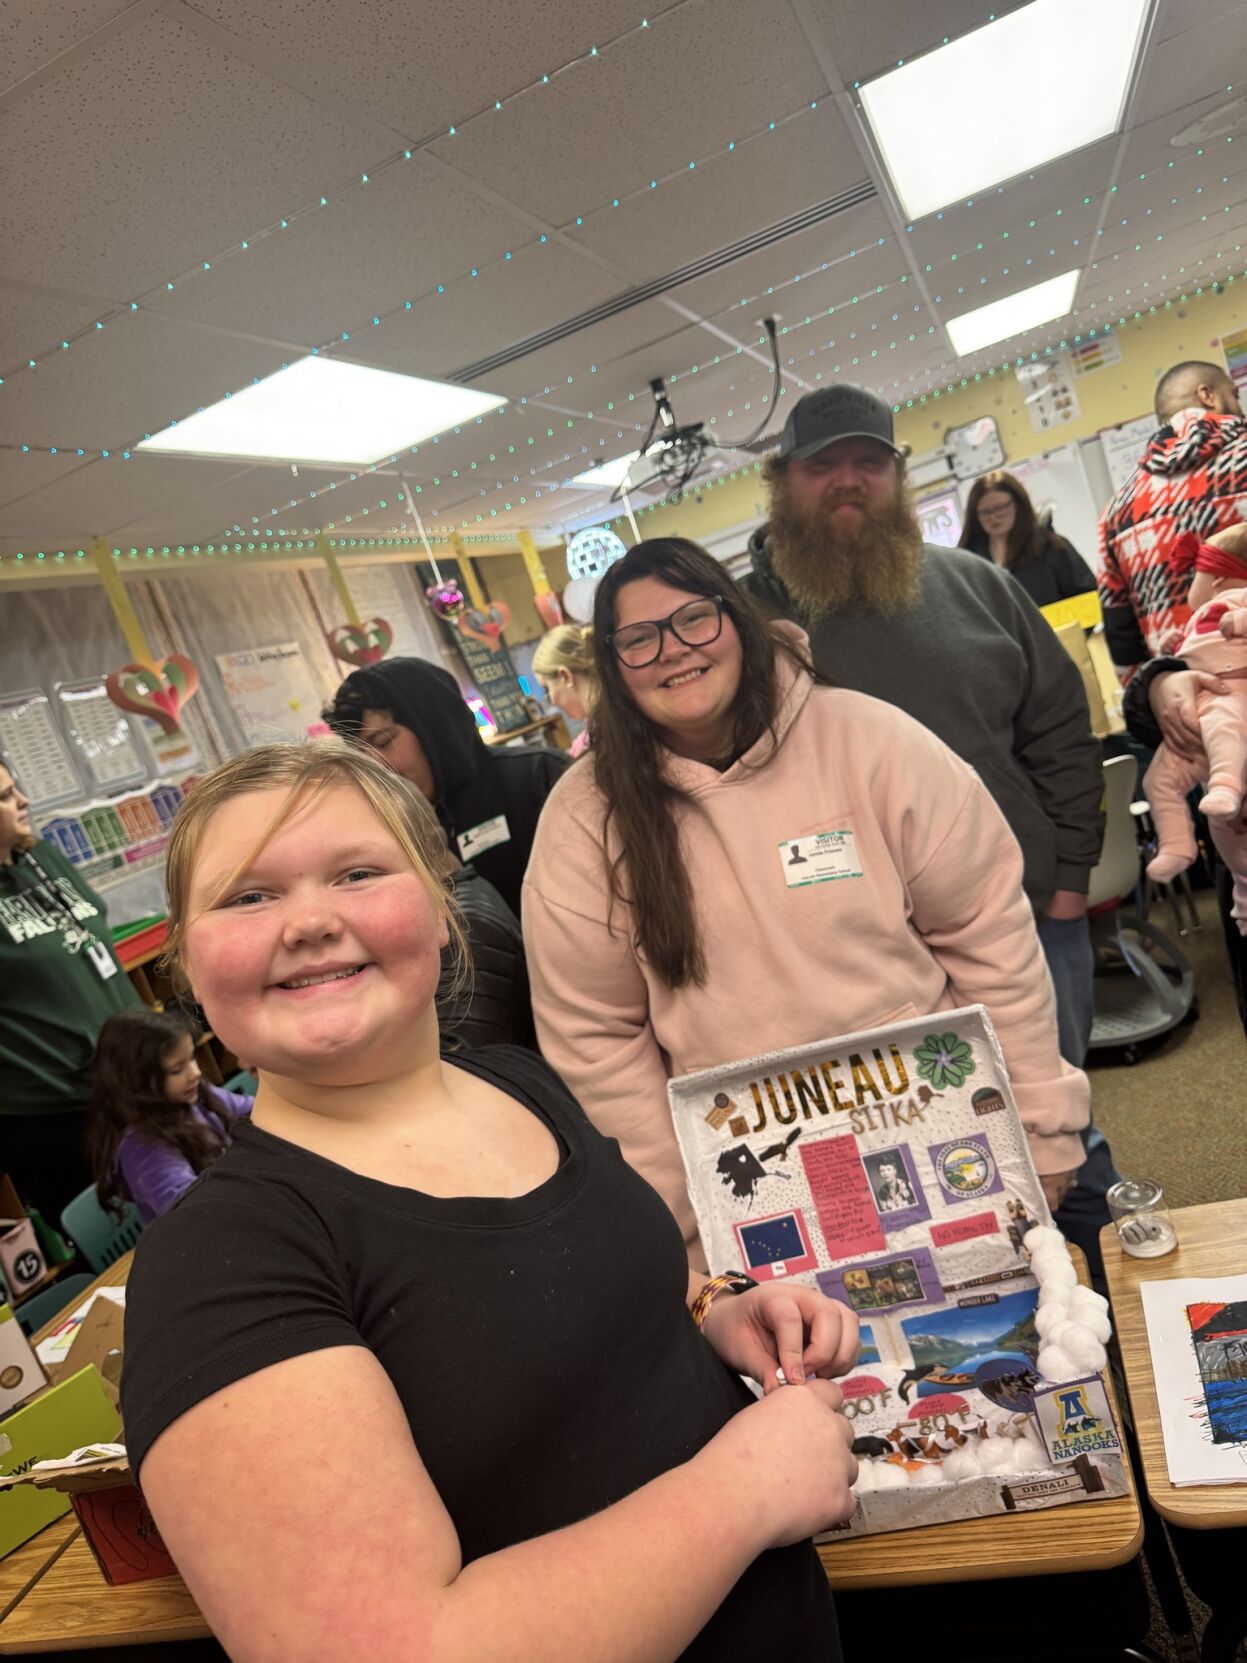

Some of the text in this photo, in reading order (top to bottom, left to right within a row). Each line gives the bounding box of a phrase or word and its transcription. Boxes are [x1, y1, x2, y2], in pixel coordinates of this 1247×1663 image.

[815, 835, 844, 845] VISITOR
[750, 1043, 910, 1133] JUNEAU
[849, 1099, 925, 1134] SITKA
[18, 1253, 38, 1278] 15
[1052, 1429, 1115, 1451] ALASKA
[1053, 1439, 1120, 1460] NANOOKS
[1021, 1479, 1070, 1494] DENALI
